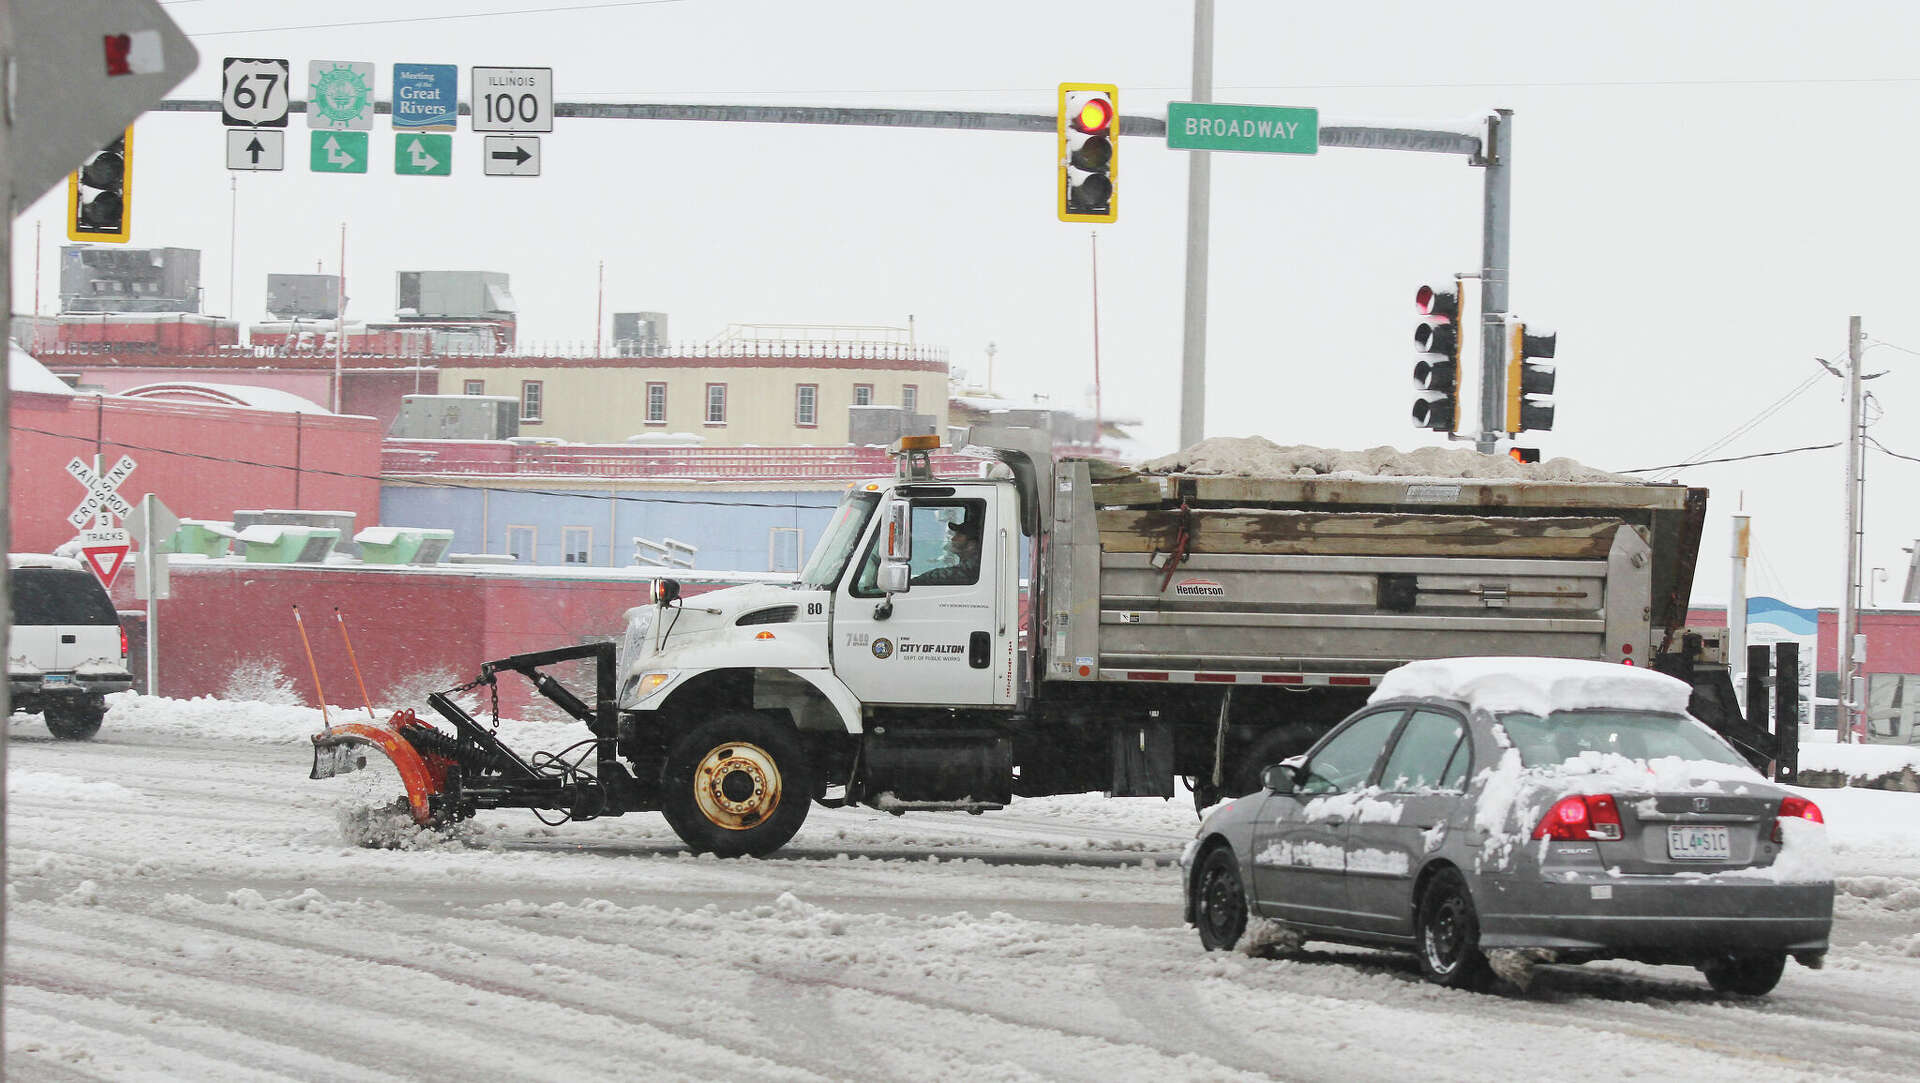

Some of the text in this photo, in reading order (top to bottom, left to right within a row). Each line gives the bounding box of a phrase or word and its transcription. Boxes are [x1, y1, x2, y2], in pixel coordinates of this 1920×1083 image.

[400, 71, 435, 81] Meeting
[488, 76, 536, 87] ILLINOIS
[233, 73, 278, 109] 67
[400, 86, 440, 100] Great
[400, 100, 447, 115] Rivers
[484, 93, 538, 123] 100
[1184, 117, 1299, 140] BROADWAY
[72, 458, 134, 526] CROSSING
[101, 515, 109, 526] 3
[86, 532, 124, 541] TRACKS
[1176, 584, 1224, 596] Henderson
[807, 602, 823, 615] 80
[899, 643, 965, 654] CITY OF ALTON
[1672, 832, 1697, 851] EL4
